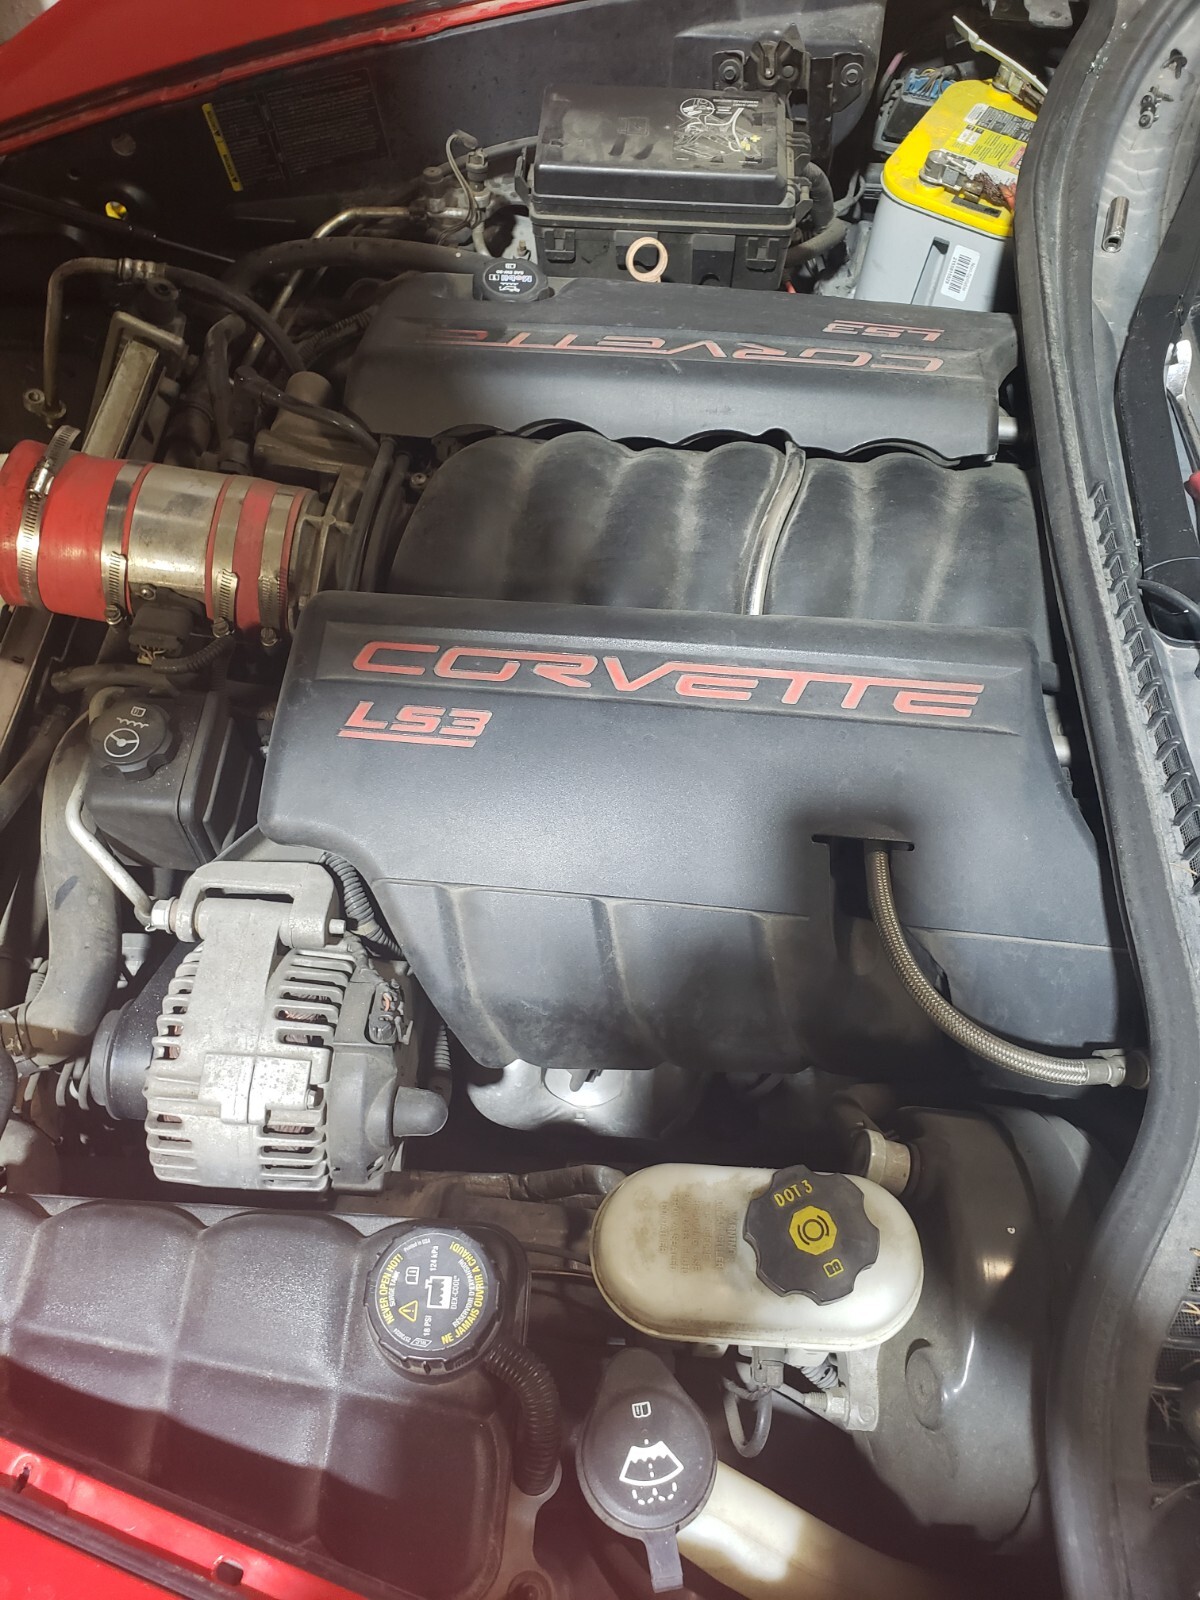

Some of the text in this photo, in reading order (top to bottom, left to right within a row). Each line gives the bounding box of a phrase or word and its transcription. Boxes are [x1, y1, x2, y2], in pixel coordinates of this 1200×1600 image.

[500, 274, 533, 283] Mobil
[821, 319, 946, 342] LS3
[420, 328, 945, 373] CORVETTE
[352, 641, 985, 718] CORVETTE
[338, 700, 493, 744] LS3
[773, 1179, 814, 1208] DOT 3
[429, 1245, 439, 1271] 124 kPa
[449, 1241, 477, 1267] CHAUD!
[379, 1253, 403, 1325] NEVER OPEN HOT!
[388, 1270, 400, 1307] SURGE TANK
[474, 1273, 485, 1307] OUVRIR
[423, 1315, 432, 1336] 18 PSI
[454, 1308, 480, 1338] JAMAIS
[441, 1332, 455, 1344] NE
